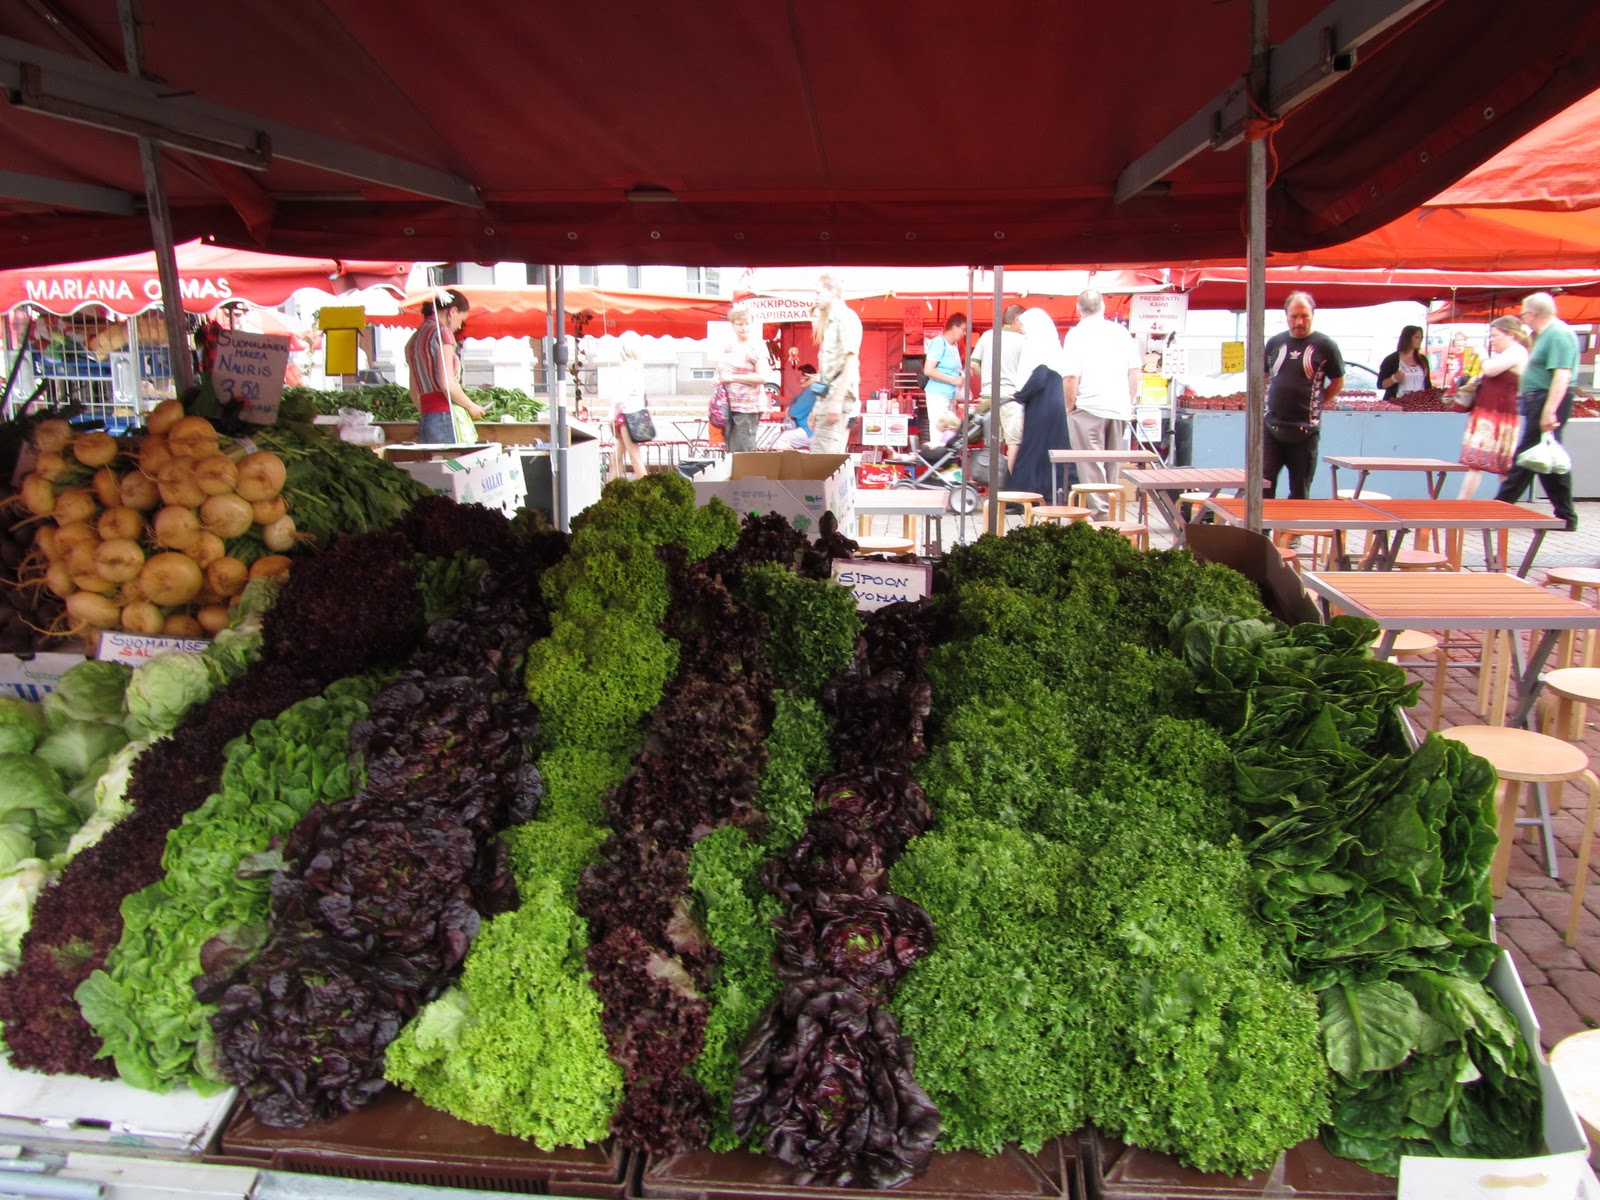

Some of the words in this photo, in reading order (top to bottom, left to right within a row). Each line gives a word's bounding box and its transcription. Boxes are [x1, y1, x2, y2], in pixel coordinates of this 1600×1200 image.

[26, 279, 134, 300] MARIANA
[143, 278, 232, 299] OMAS
[1166, 349, 1184, 361] HOT
[218, 353, 272, 377] NAURIS
[1165, 363, 1185, 375] DOG
[839, 572, 908, 587] SIPOON
